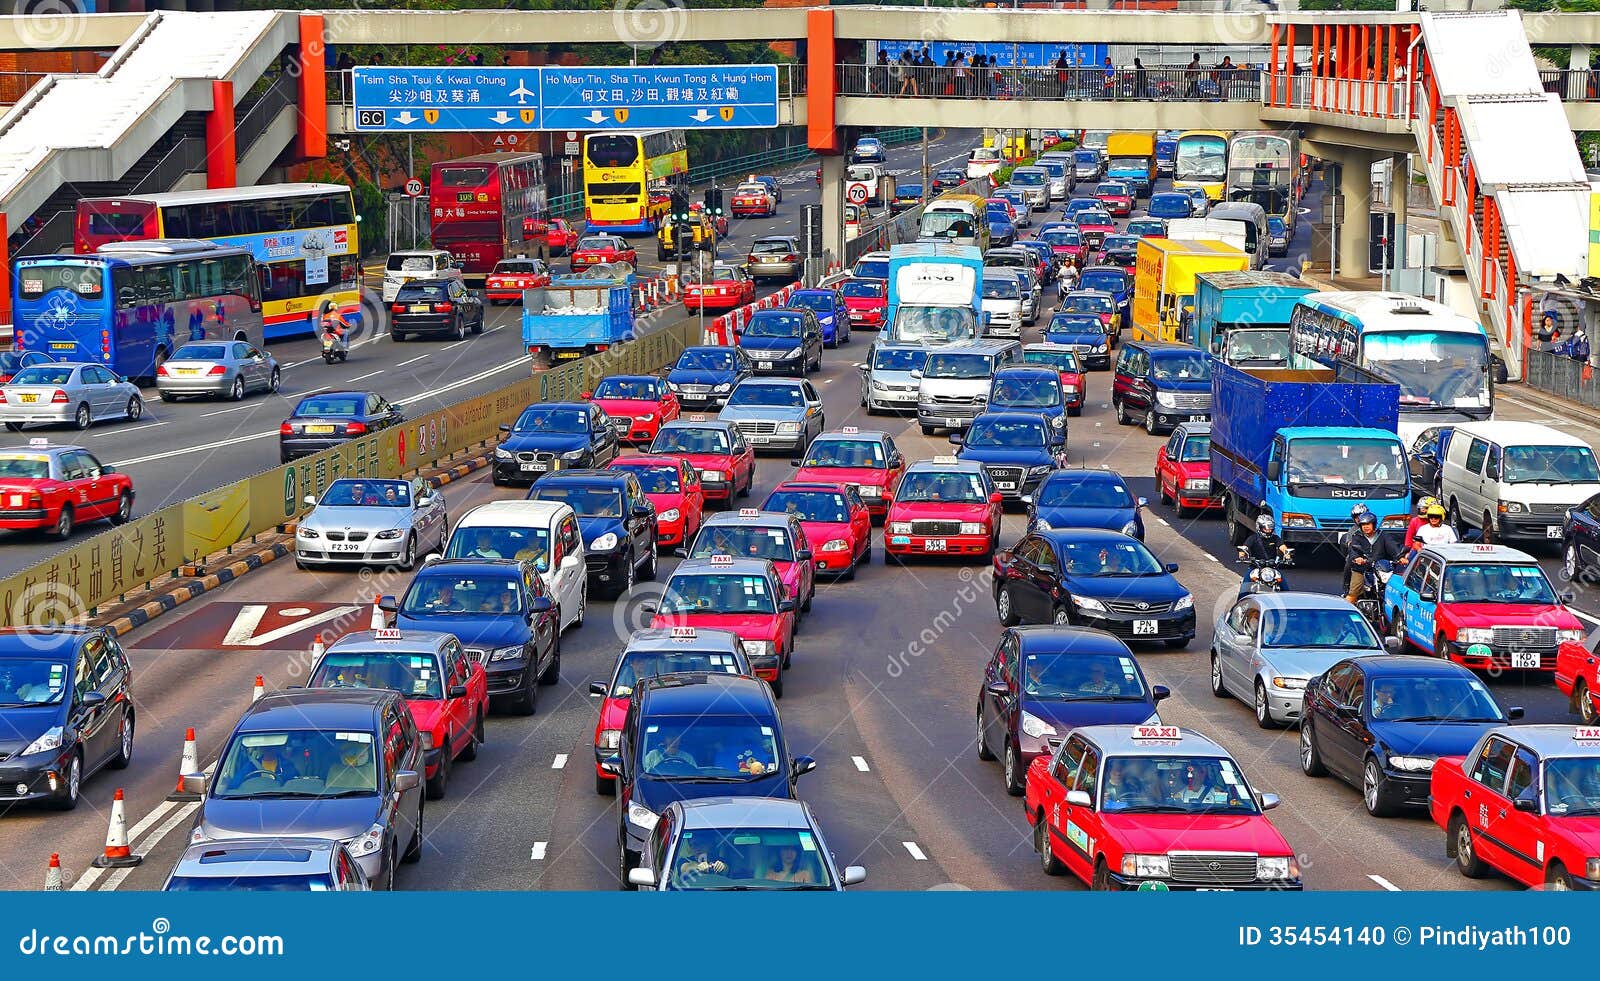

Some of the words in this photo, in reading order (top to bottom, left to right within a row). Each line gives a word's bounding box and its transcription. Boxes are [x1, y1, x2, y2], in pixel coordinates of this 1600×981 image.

[361, 75, 384, 84] Tsim
[388, 75, 408, 84] Sha
[411, 75, 432, 84] Tsui
[436, 76, 443, 84] &
[448, 75, 471, 84] Kwai
[475, 75, 506, 86] Chung
[546, 76, 559, 84] Ho
[563, 76, 583, 84] Man
[587, 75, 606, 85] Tin,
[610, 75, 628, 84] Sha
[633, 75, 651, 85] Tin,
[654, 75, 680, 84] Kwun
[685, 75, 707, 85] Tong
[711, 75, 718, 83] &
[722, 75, 747, 84] Hung
[750, 74, 772, 82] Hom
[389, 89, 480, 103] 尖沙咀及葵涌
[361, 113, 382, 124] 6C
[408, 183, 420, 192] 70
[851, 189, 866, 199] 70
[1331, 490, 1367, 498] ISUZU
[673, 628, 694, 636] TAXI
[1139, 728, 1177, 737] TAXI
[1580, 729, 1600, 737] TAX
